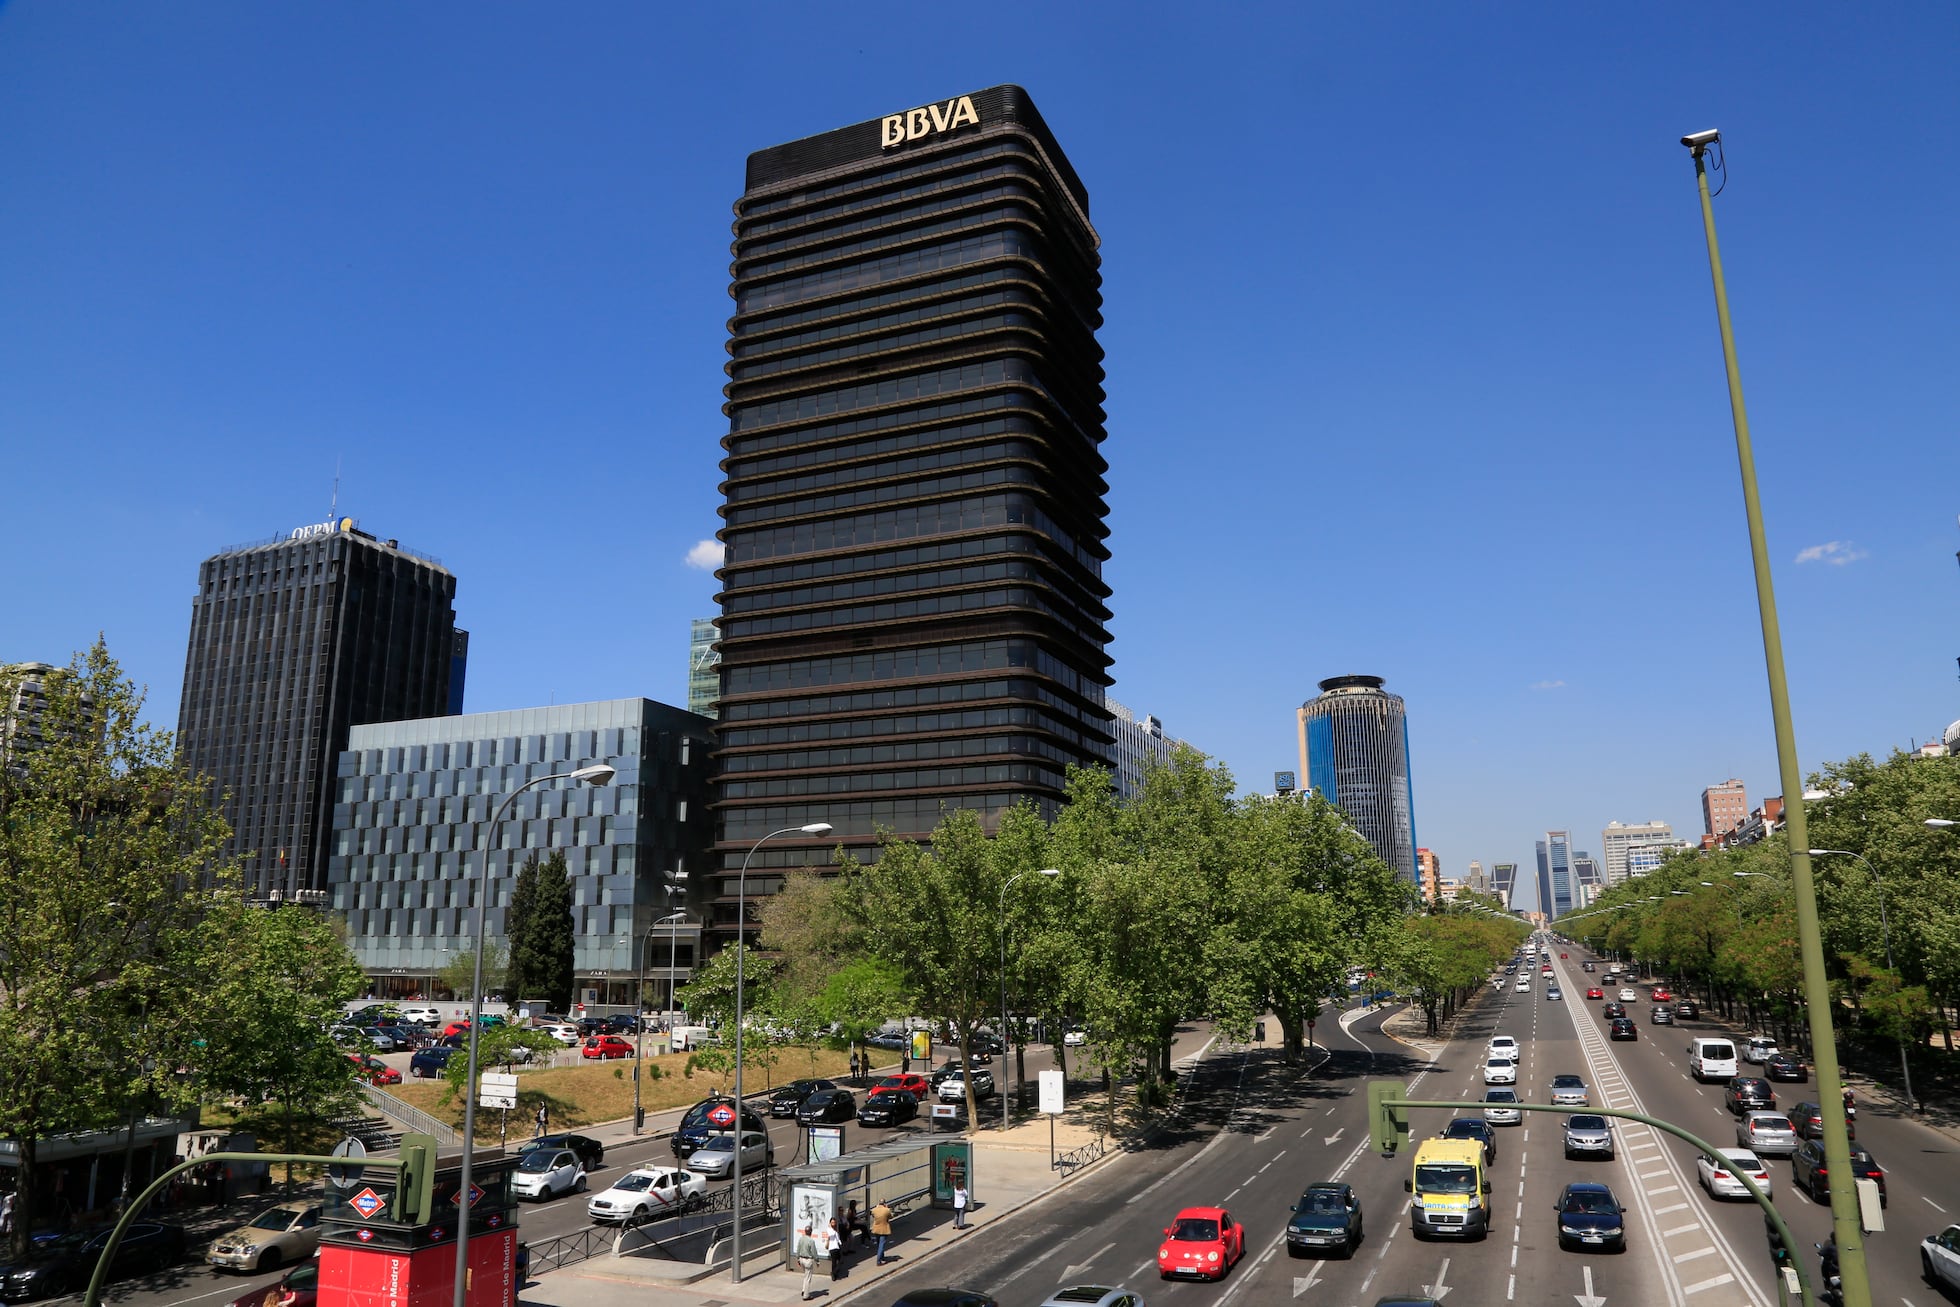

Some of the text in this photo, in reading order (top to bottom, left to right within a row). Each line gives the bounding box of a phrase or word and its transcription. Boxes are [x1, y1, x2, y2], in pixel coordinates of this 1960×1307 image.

[881, 96, 979, 148] BBVA
[291, 520, 336, 539] OEPM
[359, 1198, 375, 1207] Metro
[503, 1236, 511, 1270] Madrid
[390, 1259, 399, 1297] Madrid
[503, 1273, 510, 1286] de
